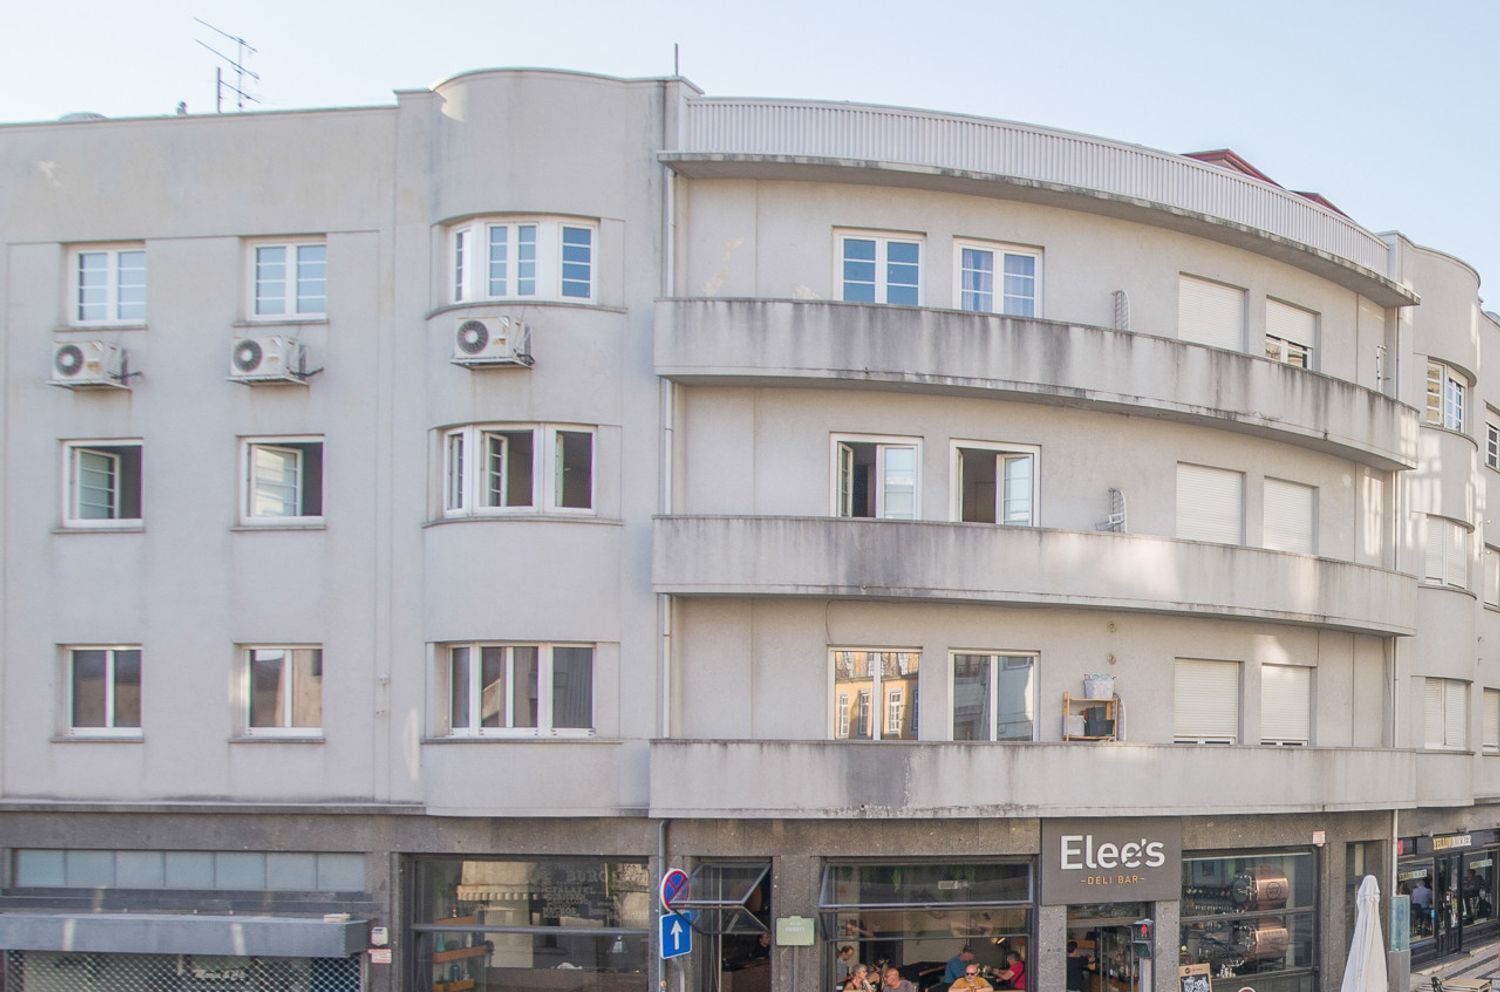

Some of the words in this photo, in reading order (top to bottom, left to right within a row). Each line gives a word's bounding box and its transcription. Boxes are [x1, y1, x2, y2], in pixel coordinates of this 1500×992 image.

[1061, 835, 1165, 869] Elee's
[1087, 876, 1112, 885] DELI
[1118, 876, 1138, 884] BAR
